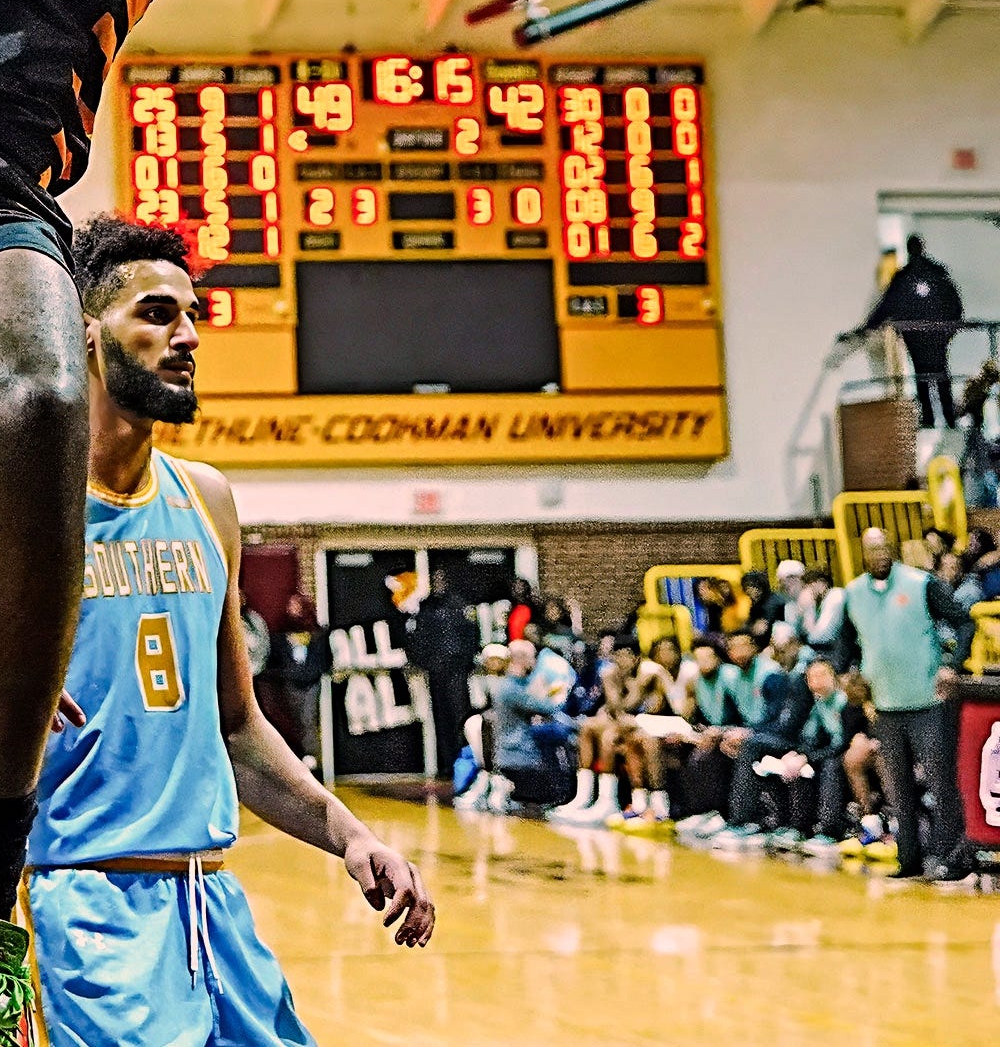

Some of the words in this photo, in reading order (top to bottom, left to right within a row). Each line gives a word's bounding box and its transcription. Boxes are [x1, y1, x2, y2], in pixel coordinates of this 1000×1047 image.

[375, 57, 474, 104] 16:15
[296, 83, 353, 131] 49
[489, 83, 545, 131] 42
[562, 87, 602, 123] 30
[624, 86, 650, 122] 0
[672, 87, 697, 121] 0
[145, 121, 178, 158] 13
[455, 117, 480, 155] 2
[626, 121, 652, 155] 0
[675, 121, 698, 155] 0
[134, 155, 179, 191] 01
[251, 155, 277, 192] 0
[308, 187, 335, 226] 2
[353, 187, 377, 225] 3
[471, 187, 493, 225] 3
[516, 186, 542, 225] 0
[632, 222, 658, 258] 6
[681, 222, 704, 257] 2
[210, 290, 233, 327] 3
[638, 286, 661, 324] 3
[153, 414, 493, 446] ETHUNE-COOKMAN
[507, 410, 711, 443] UNIVERSITY
[135, 612, 185, 712] 8
[329, 620, 408, 670] ALL
